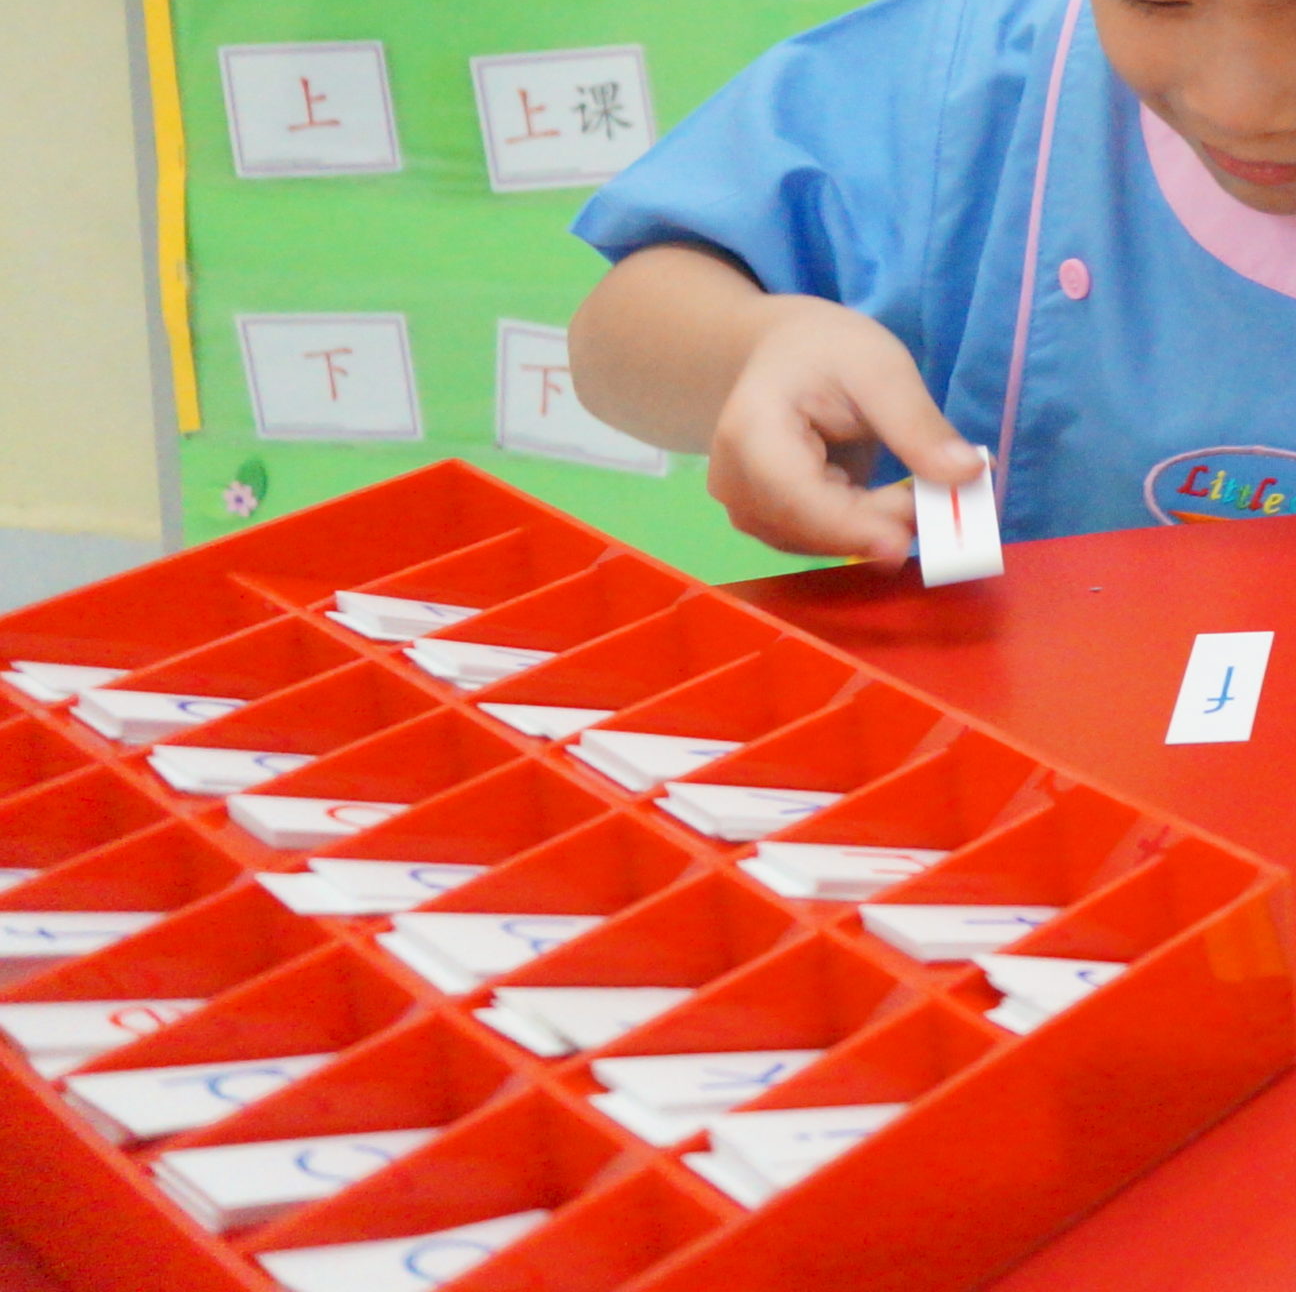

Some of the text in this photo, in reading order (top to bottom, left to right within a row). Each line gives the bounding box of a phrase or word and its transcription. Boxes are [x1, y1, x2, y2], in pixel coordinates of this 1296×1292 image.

[286, 77, 340, 132] 上
[506, 82, 632, 145] 上课
[304, 347, 353, 402] 下
[1177, 464, 1286, 515] Little
[1202, 666, 1235, 714] f
